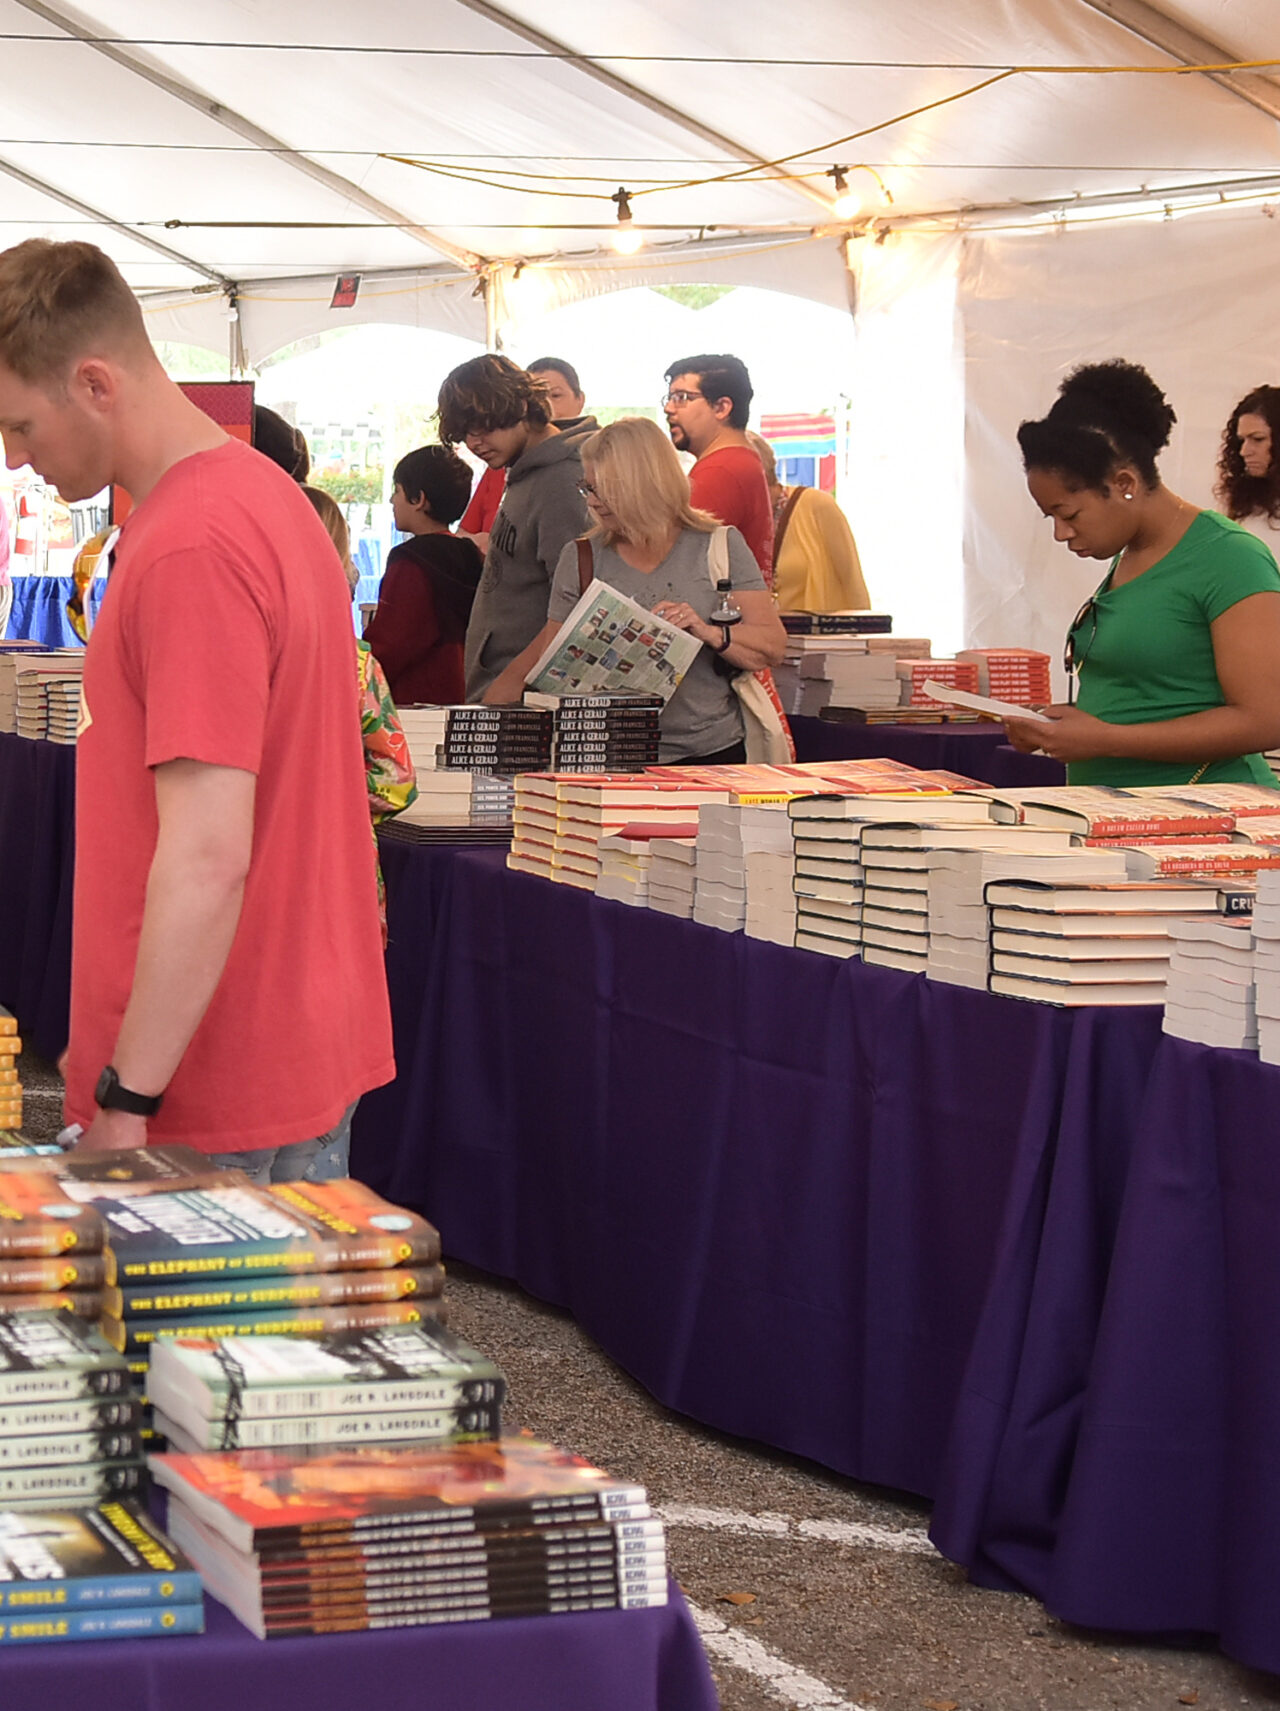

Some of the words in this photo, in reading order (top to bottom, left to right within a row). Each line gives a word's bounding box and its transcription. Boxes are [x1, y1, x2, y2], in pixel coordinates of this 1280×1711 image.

[564, 699, 581, 707] ALICE
[588, 699, 611, 707] GERALD
[454, 712, 470, 720] ALICE
[478, 712, 501, 720] GERALD
[561, 711, 577, 719] ALICE
[584, 711, 607, 719] GERALD
[452, 723, 469, 731] ALICE
[476, 723, 500, 731] GERALD
[560, 722, 576, 730] ALICE
[583, 722, 606, 730] GERALD
[450, 734, 467, 742] ALICE
[474, 734, 498, 742] GERALD
[564, 733, 580, 741] ALICE
[586, 733, 610, 741] GERALD
[449, 745, 466, 753] ALICE
[473, 745, 496, 753] GERALD
[560, 744, 576, 752] ALICE
[583, 744, 606, 752] GERALD
[452, 756, 468, 764] ALICE
[475, 756, 498, 764] GERALD
[560, 755, 577, 763] ALICE
[583, 755, 607, 763] GERALD
[1231, 898, 1253, 910] CRU
[149, 1257, 225, 1275] ELEPHANT
[155, 1292, 232, 1310] ELEPHANT
[341, 1392, 363, 1405] JOE
[337, 1422, 359, 1434] JOE
[8, 1588, 67, 1607] SMILE
[10, 1621, 68, 1640] SMILE
